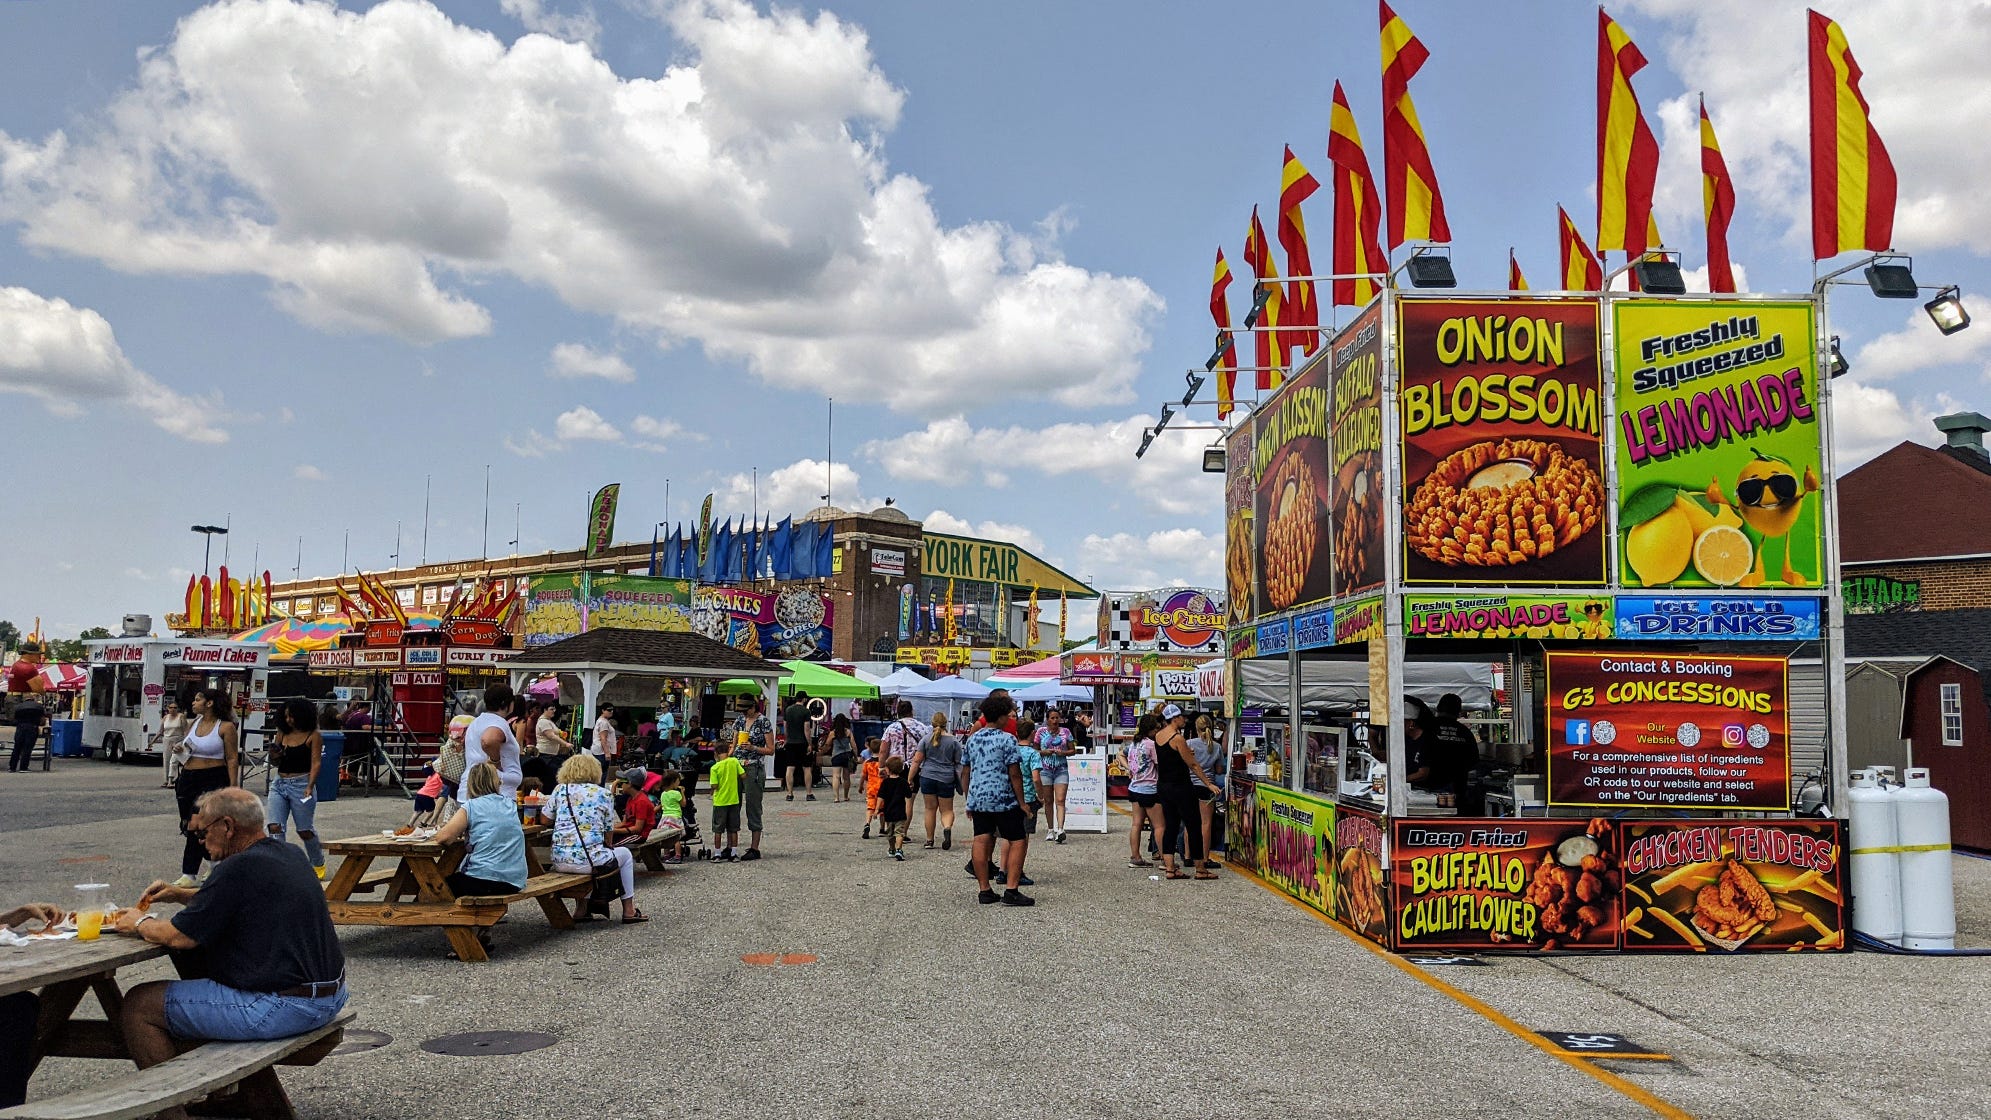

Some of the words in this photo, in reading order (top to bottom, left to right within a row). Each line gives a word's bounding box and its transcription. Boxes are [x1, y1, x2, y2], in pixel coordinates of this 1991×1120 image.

[1641, 315, 1759, 362] Freshly
[1633, 335, 1783, 393] Squeezed
[1335, 352, 1375, 422] BUFFALO
[1405, 374, 1601, 436] BLOSSOM
[1282, 386, 1327, 446] BLOSSOM
[1621, 368, 1813, 464] LEMONADE
[923, 538, 974, 577] YORK
[979, 547, 1019, 582] FAIR
[429, 566, 447, 574] YORK
[451, 564, 468, 572] FAIR
[536, 588, 573, 600] SQUEEZED
[605, 590, 673, 603] SQUEEZED
[600, 603, 680, 622] LEMONADE
[713, 593, 762, 615] CAKES
[1412, 600, 1451, 612] Freshly
[1455, 596, 1507, 609] Squeezed
[1710, 600, 1784, 614] COLD
[1141, 606, 1171, 626] Ice
[1412, 603, 1570, 635] LEMONADE
[368, 628, 382, 638] Curly
[386, 628, 399, 637] Fries
[451, 626, 475, 635] Corn
[475, 631, 498, 641] Dogs
[783, 622, 815, 639] OREO
[182, 646, 222, 663] Funnel
[223, 648, 258, 664] Cakes
[310, 652, 329, 664] CORN
[330, 651, 350, 664] DOGS
[450, 652, 485, 661] CURLY
[1600, 659, 1656, 674] Contact
[1660, 662, 1671, 674] &
[1675, 661, 1733, 677] Booking
[414, 673, 441, 684] ATM
[1563, 686, 1595, 710] G3
[1647, 722, 1666, 732] Our
[1637, 734, 1676, 745] Website
[1573, 751, 1591, 762] For
[1602, 753, 1677, 764] comprehensive
[1680, 753, 1696, 763] list
[1699, 753, 1709, 763] of
[1710, 754, 1764, 766] ingredients
[1591, 765, 1616, 774] used
[1618, 765, 1628, 774] in
[1631, 767, 1647, 775] our
[1699, 766, 1728, 777] follow
[1730, 768, 1747, 776] our
[1584, 777, 1600, 788] QR
[1603, 778, 1628, 787] code
[1631, 779, 1641, 788] to
[1663, 779, 1701, 789] website
[1703, 780, 1722, 789] and
[1725, 780, 1754, 790] select
[1598, 792, 1611, 800] on
[1614, 791, 1630, 800] the
[1633, 791, 1656, 801] "Our
[1659, 792, 1718, 803] Ingredients"
[1721, 794, 1740, 803] tab.
[1407, 829, 1464, 848] Deep
[1470, 829, 1528, 848] Fried
[1729, 826, 1834, 875] TENDERS
[1411, 851, 1525, 894] BUFFALO
